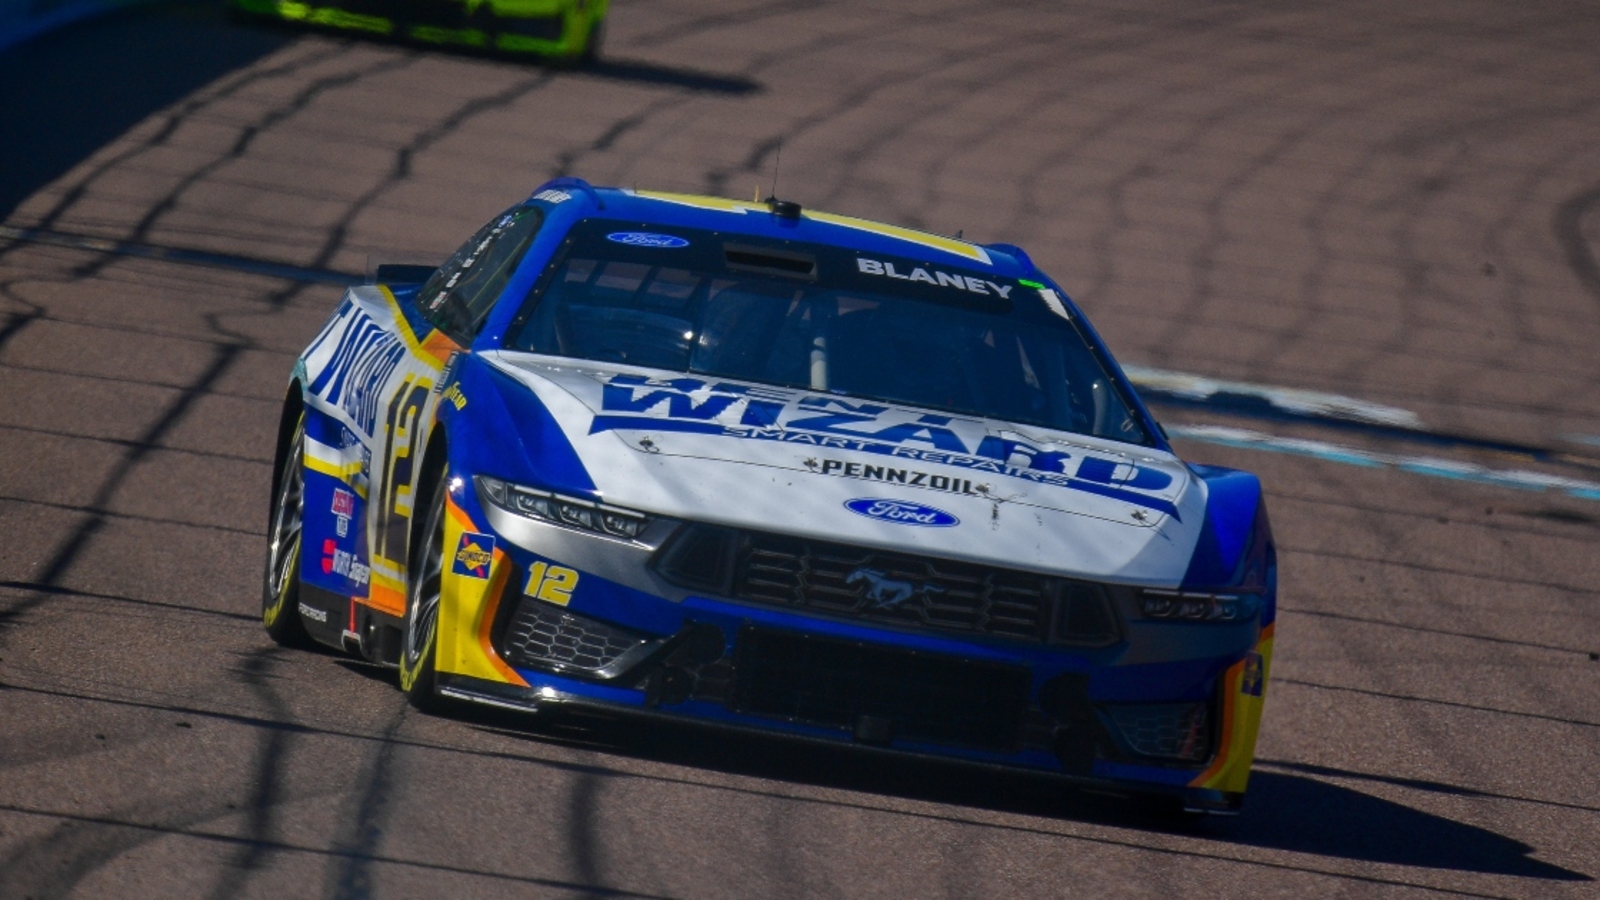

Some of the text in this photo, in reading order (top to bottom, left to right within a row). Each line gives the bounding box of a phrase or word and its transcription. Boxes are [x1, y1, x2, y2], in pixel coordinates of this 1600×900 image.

[622, 234, 673, 247] Ford
[857, 258, 1013, 300] BLANEY
[602, 383, 1174, 491] WIZARD
[721, 425, 1069, 487] SMART REPAIRS
[373, 373, 434, 572] 12
[822, 459, 979, 496] PENNZOIL
[867, 500, 937, 524] Ford
[456, 551, 491, 564] SUNOCO
[523, 560, 579, 607] 12
